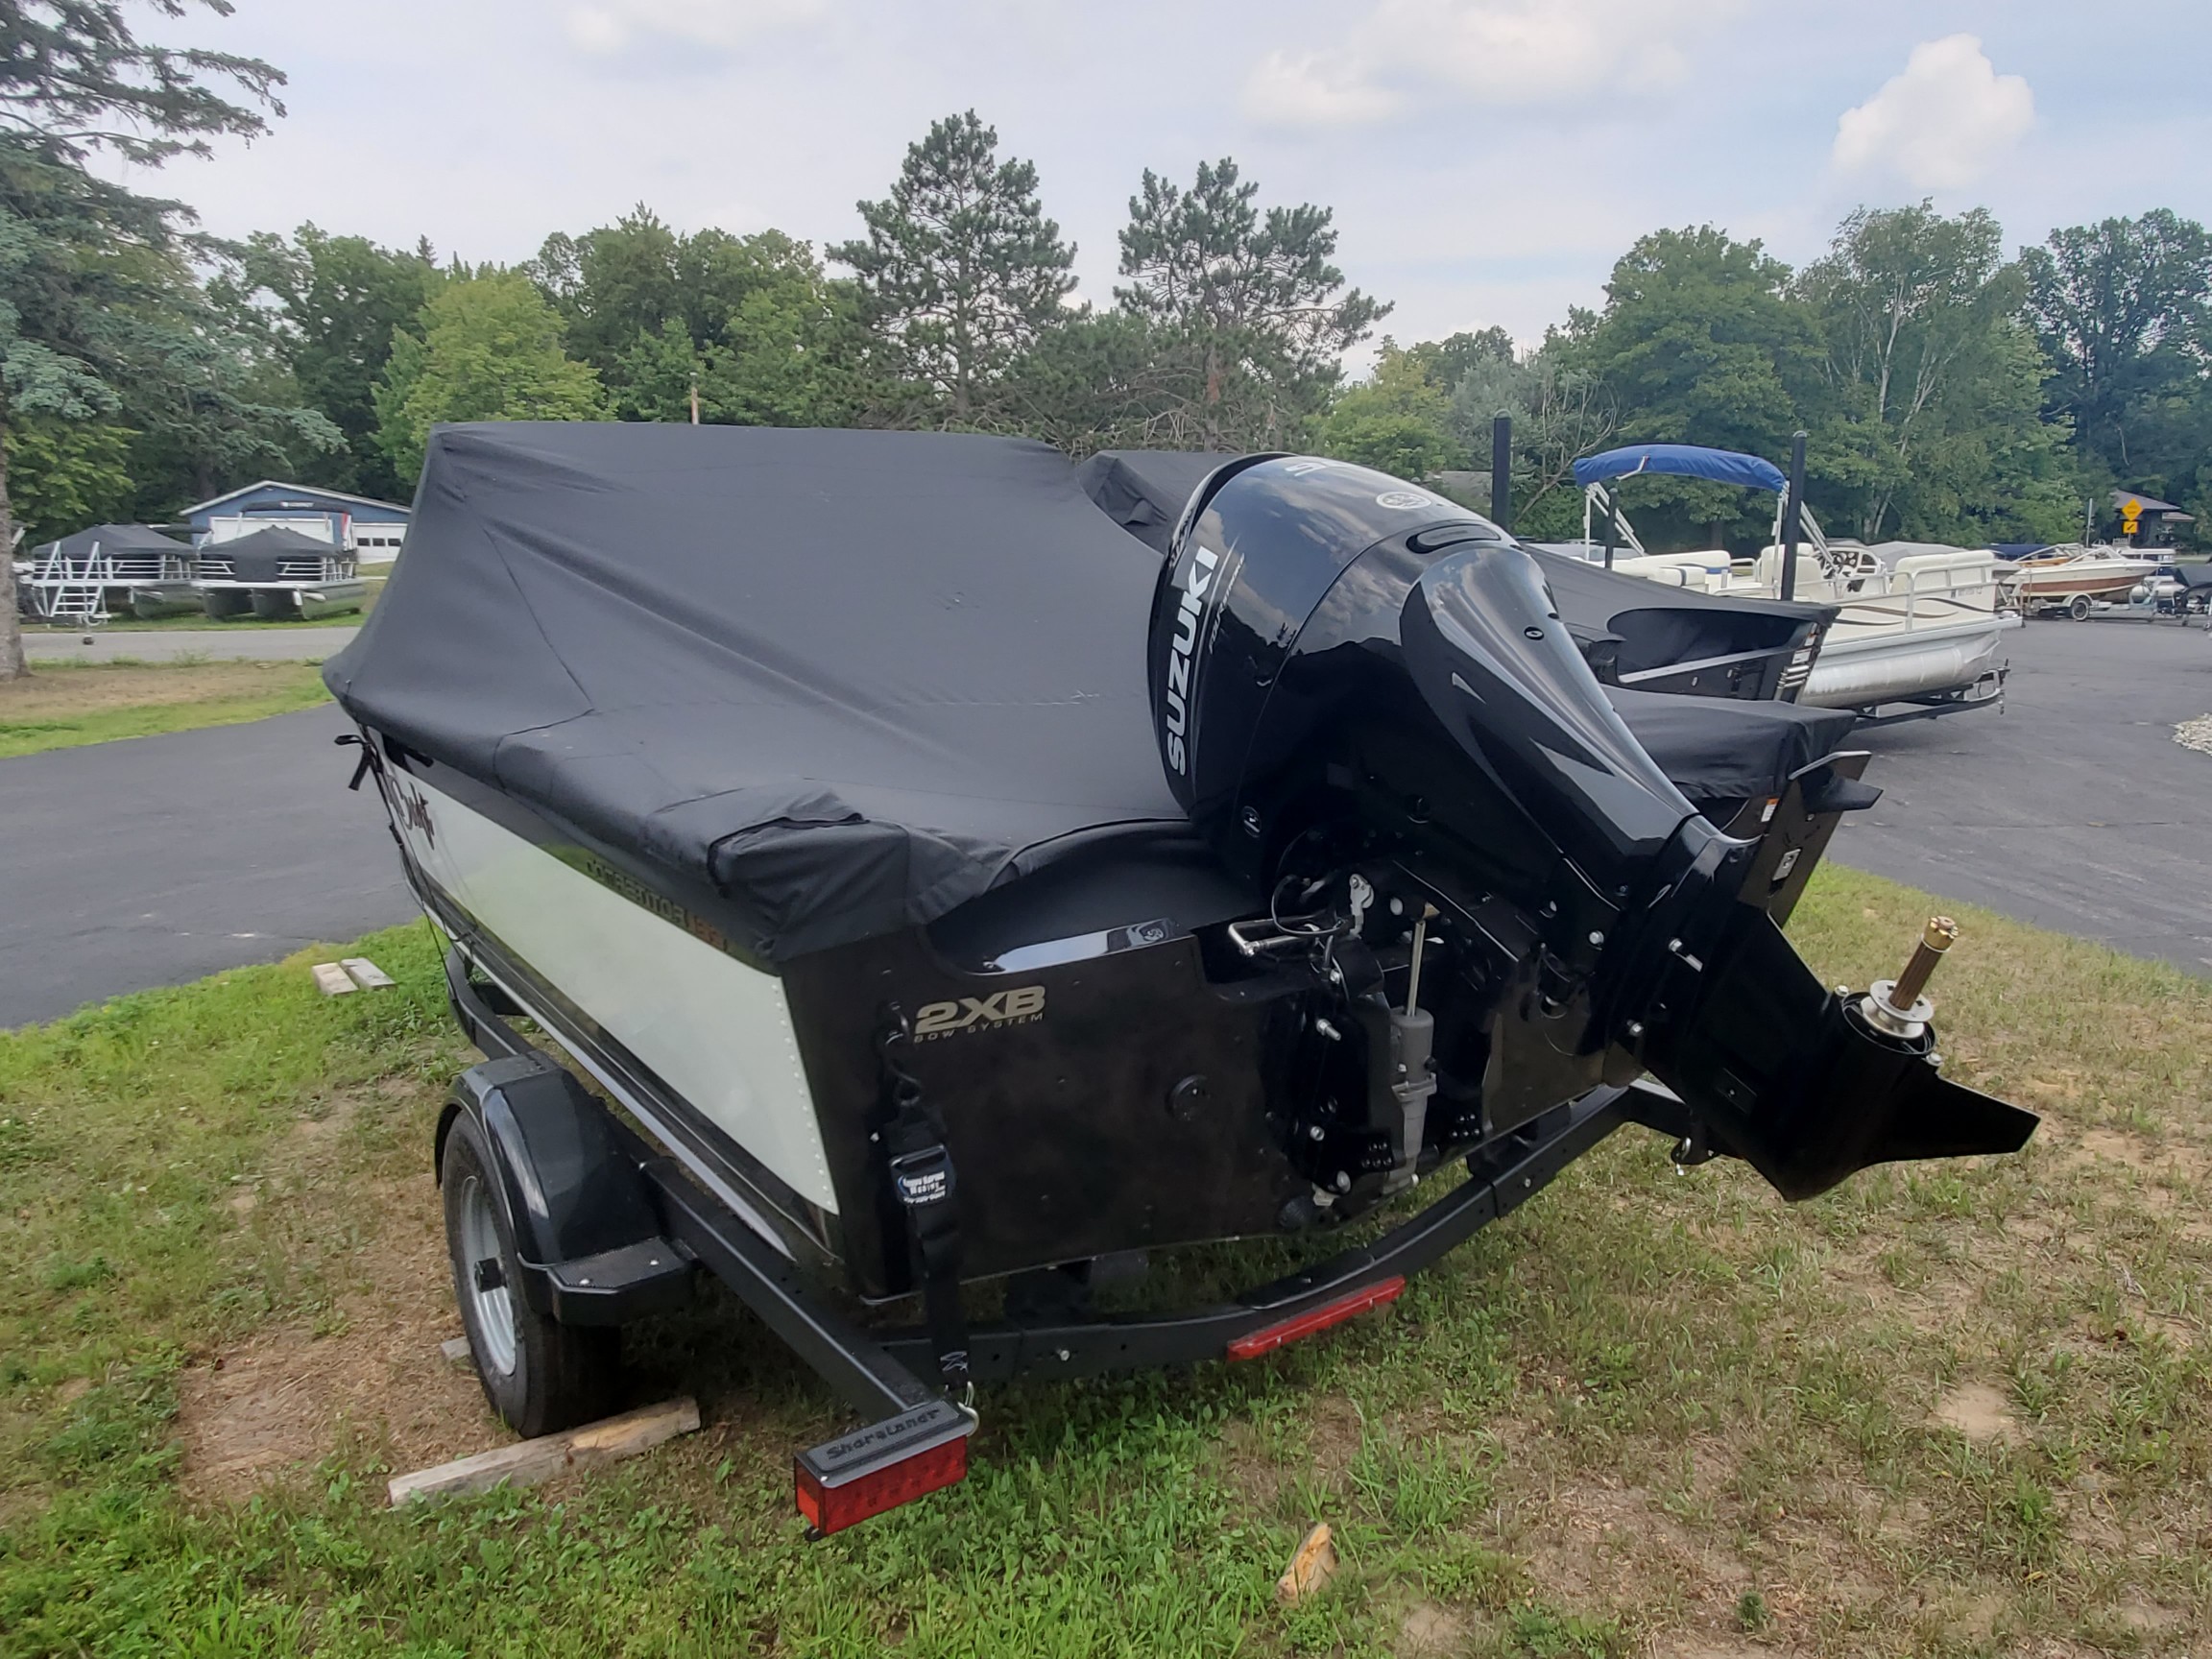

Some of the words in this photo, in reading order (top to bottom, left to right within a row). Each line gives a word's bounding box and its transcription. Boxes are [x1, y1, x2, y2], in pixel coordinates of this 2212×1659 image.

[1166, 545, 1218, 776] SUZUKI
[913, 1029, 954, 1044] BOW
[967, 1013, 1044, 1034] SYSTEM
[915, 985, 1046, 1035] 2XB
